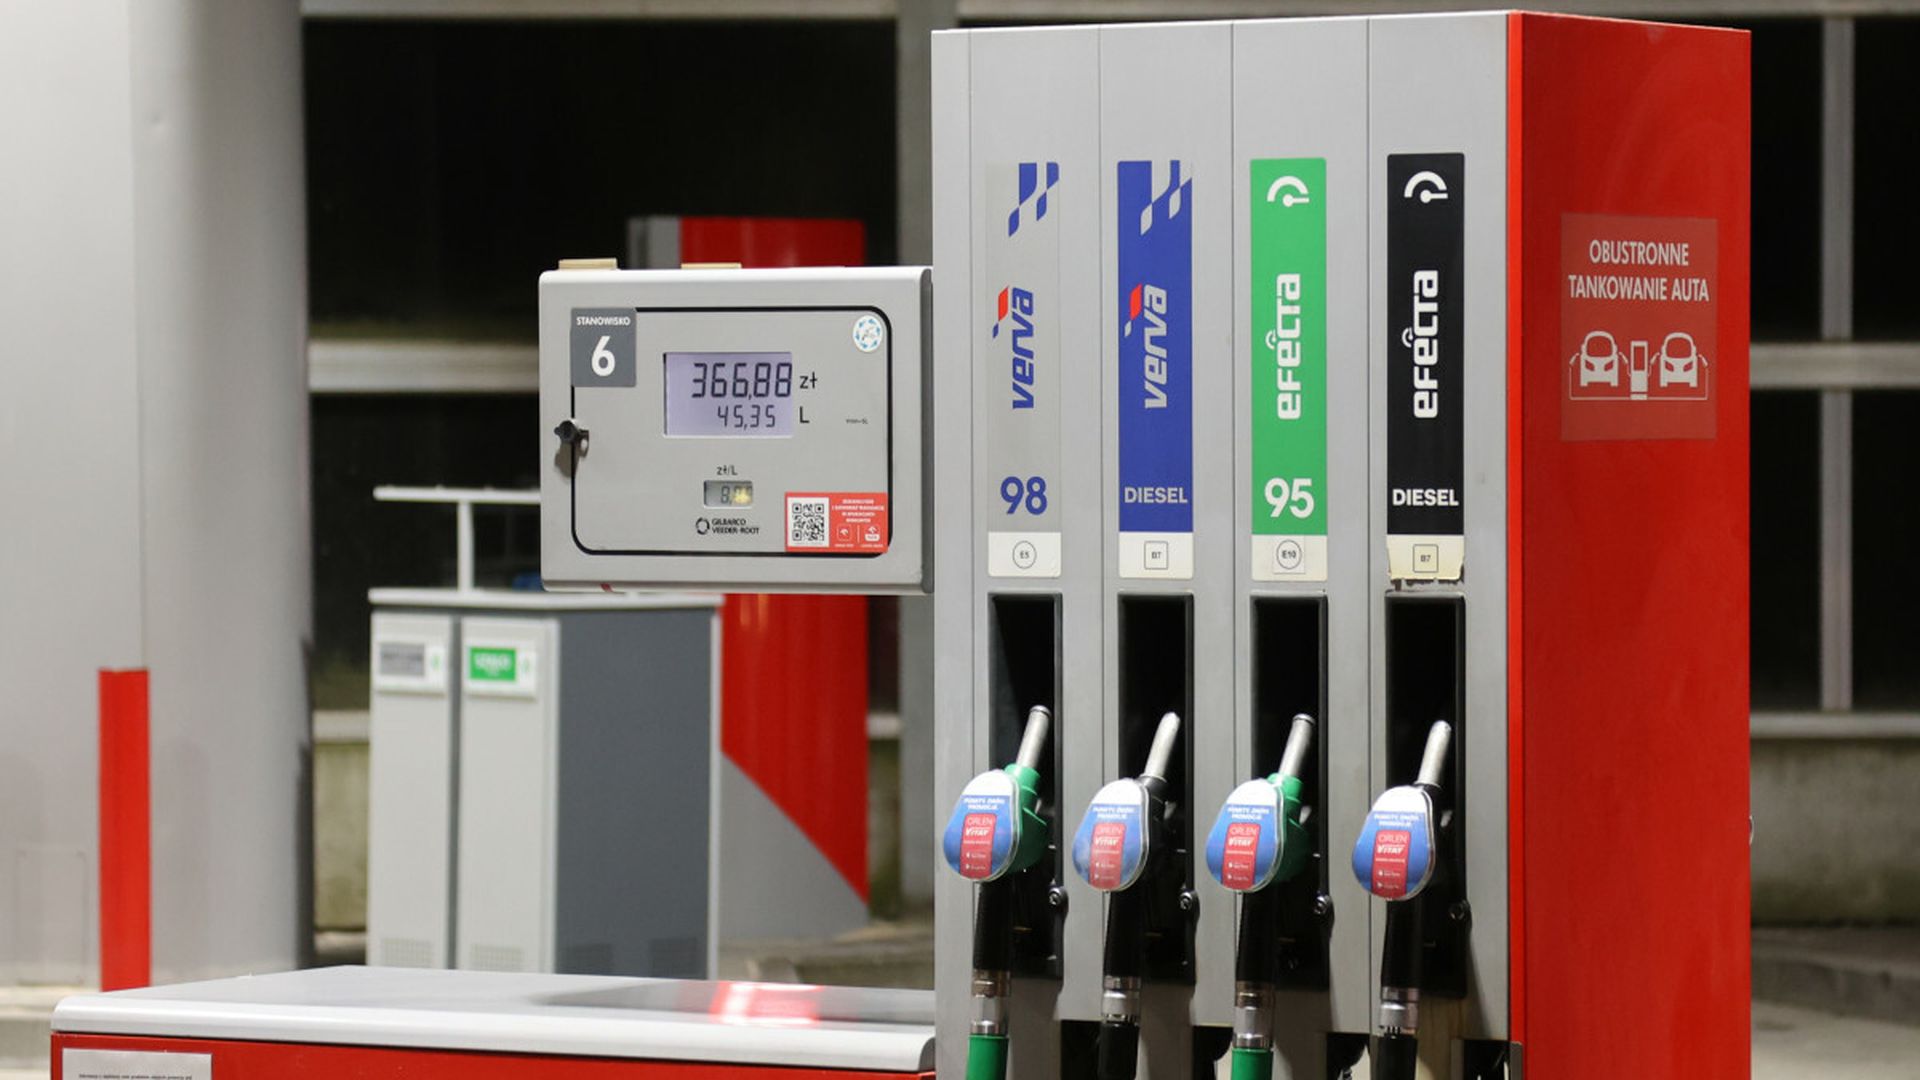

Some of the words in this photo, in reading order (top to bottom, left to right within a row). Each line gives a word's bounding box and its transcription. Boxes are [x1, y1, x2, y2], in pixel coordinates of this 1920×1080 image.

[1589, 239, 1689, 266] OBUSTRONNE
[1568, 274, 1668, 300] TANKOWANIE
[1671, 277, 1710, 302] AUTA
[576, 315, 632, 326] STANOWISKO
[591, 335, 616, 377] 6
[1011, 287, 1035, 410] verva
[1143, 284, 1168, 409] verva
[691, 361, 793, 401] 366,88
[799, 371, 818, 389] zł
[716, 404, 776, 431] 45,35
[799, 405, 811, 424] L
[1000, 476, 1048, 515] 98
[1124, 487, 1189, 504] DIESEL
[1264, 477, 1315, 519] 95
[1392, 488, 1460, 506] DIESEL
[1151, 551, 1162, 560] B7
[1281, 550, 1297, 559] E10
[1420, 554, 1431, 563] B7
